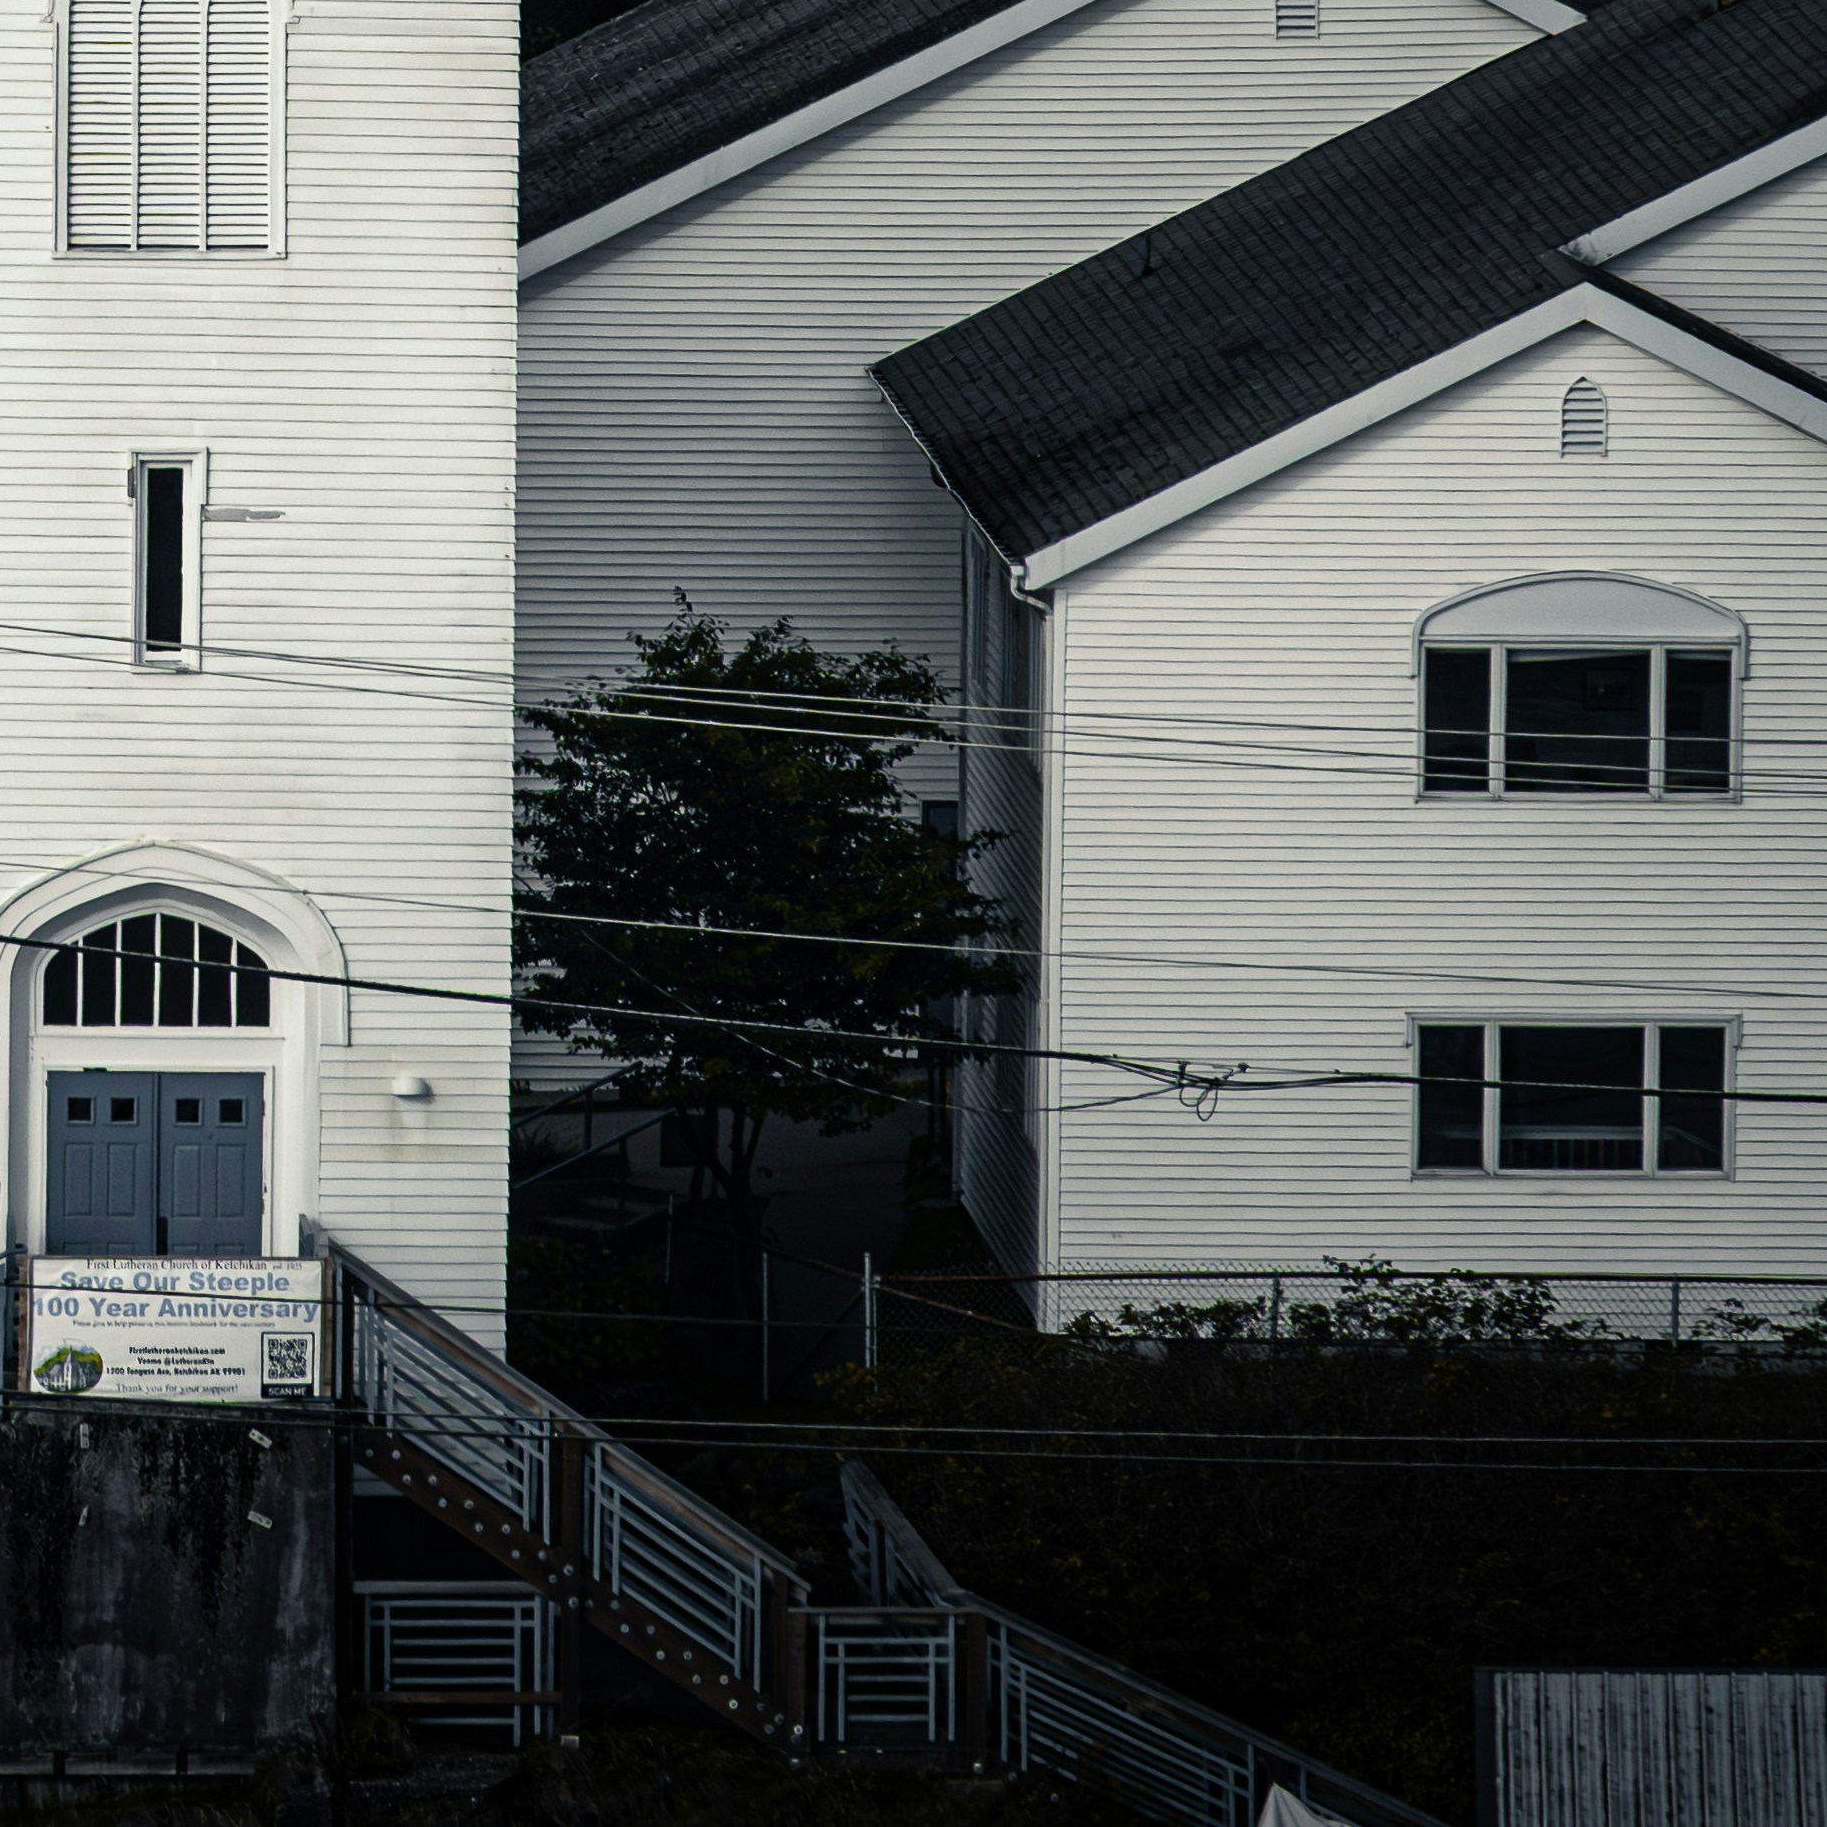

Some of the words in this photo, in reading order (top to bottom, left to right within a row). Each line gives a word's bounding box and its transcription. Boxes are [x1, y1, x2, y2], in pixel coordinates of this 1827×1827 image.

[86, 1259, 109, 1270] First
[113, 1259, 159, 1270] Lutheran
[161, 1259, 198, 1270] Church
[200, 1259, 212, 1270] of
[215, 1259, 267, 1270] Ketchikan
[60, 1271, 124, 1291] Save
[133, 1271, 181, 1291] Our
[189, 1271, 290, 1296] Steeple
[34, 1297, 80, 1317] 100
[89, 1297, 150, 1318] Year
[158, 1298, 319, 1323] Anniversary
[106, 1367, 125, 1375] 1200
[210, 1367, 220, 1376] AK
[116, 1383, 143, 1393] Thank
[145, 1385, 162, 1395] you
[165, 1383, 177, 1393] for
[179, 1385, 200, 1395] your
[202, 1384, 239, 1395] support!
[268, 1387, 292, 1396] SCAN
[294, 1387, 307, 1396] ME
